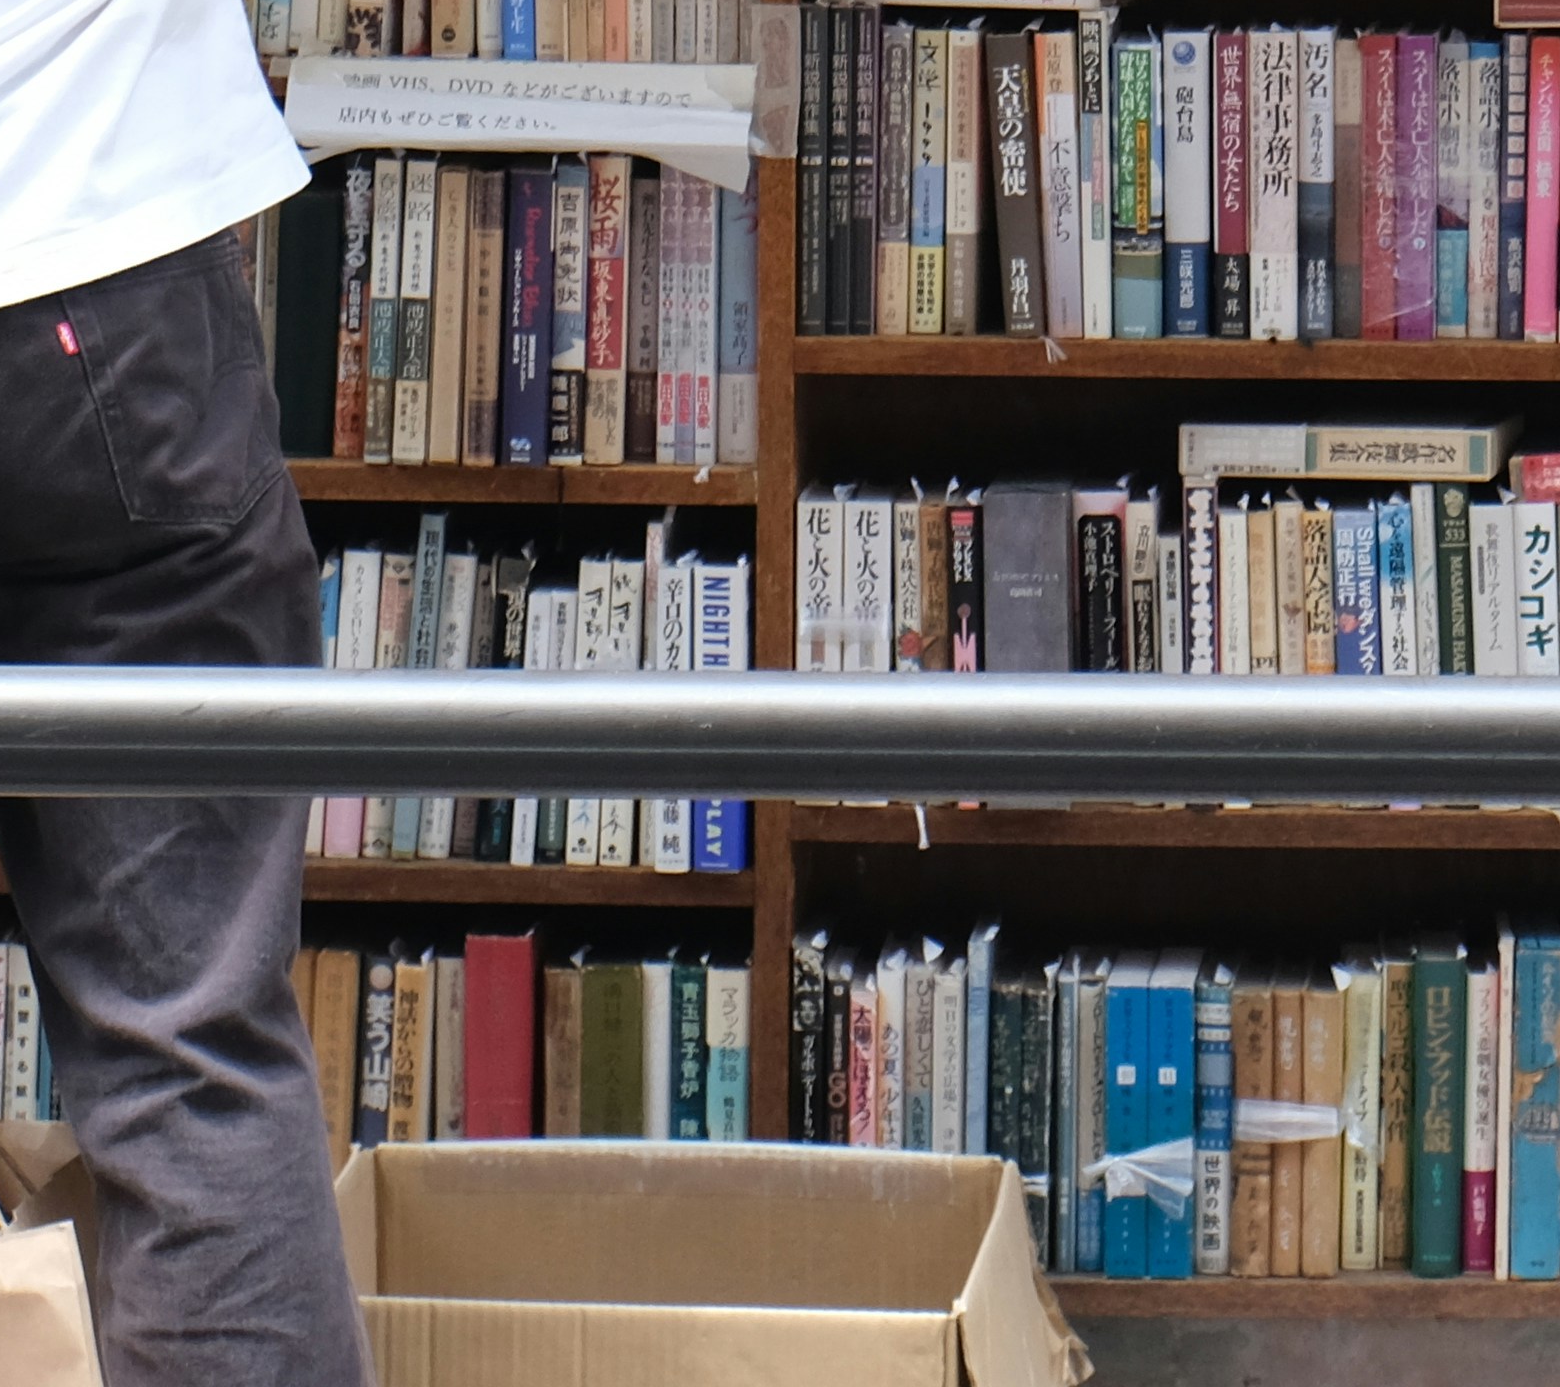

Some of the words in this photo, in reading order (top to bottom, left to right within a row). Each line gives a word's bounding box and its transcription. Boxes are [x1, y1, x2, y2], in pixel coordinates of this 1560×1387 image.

[447, 77, 494, 95] DVD
[502, 81, 693, 109] などがございますので
[1303, 42, 1329, 100] 汚名
[338, 106, 558, 132] 店内もぜひご覧ください。
[995, 63, 1029, 197] 天皇の密使
[1175, 86, 1195, 144] 砲台島
[1219, 47, 1243, 213] 世界無宿の女たち
[1261, 42, 1293, 200] 法律事務所
[1376, 48, 1394, 238] スパイは未亡人を残した
[407, 172, 433, 221] 迷路
[590, 171, 620, 256] 桜雨
[1048, 140, 1072, 243] 不意撃ち
[557, 192, 581, 304] 吉原御免状
[403, 303, 423, 380] 池波正太郎
[1328, 441, 1456, 465] 名作歌舞伎全集
[806, 507, 832, 618] 花と火の帝
[854, 510, 881, 618] 花と火の帝
[1083, 523, 1098, 592] 小池真理子
[1337, 527, 1357, 606] 周防正行
[1355, 526, 1377, 575] Shall
[1389, 509, 1409, 672] 心を遠隔管理する社会
[1520, 524, 1555, 656] カシコギ
[702, 576, 730, 648] NIGHT
[1356, 578, 1376, 608] we
[1356, 607, 1377, 675] ダンス?
[361, 994, 394, 1112] 笑う山崎
[1201, 1154, 1222, 1253] 世界の映画
